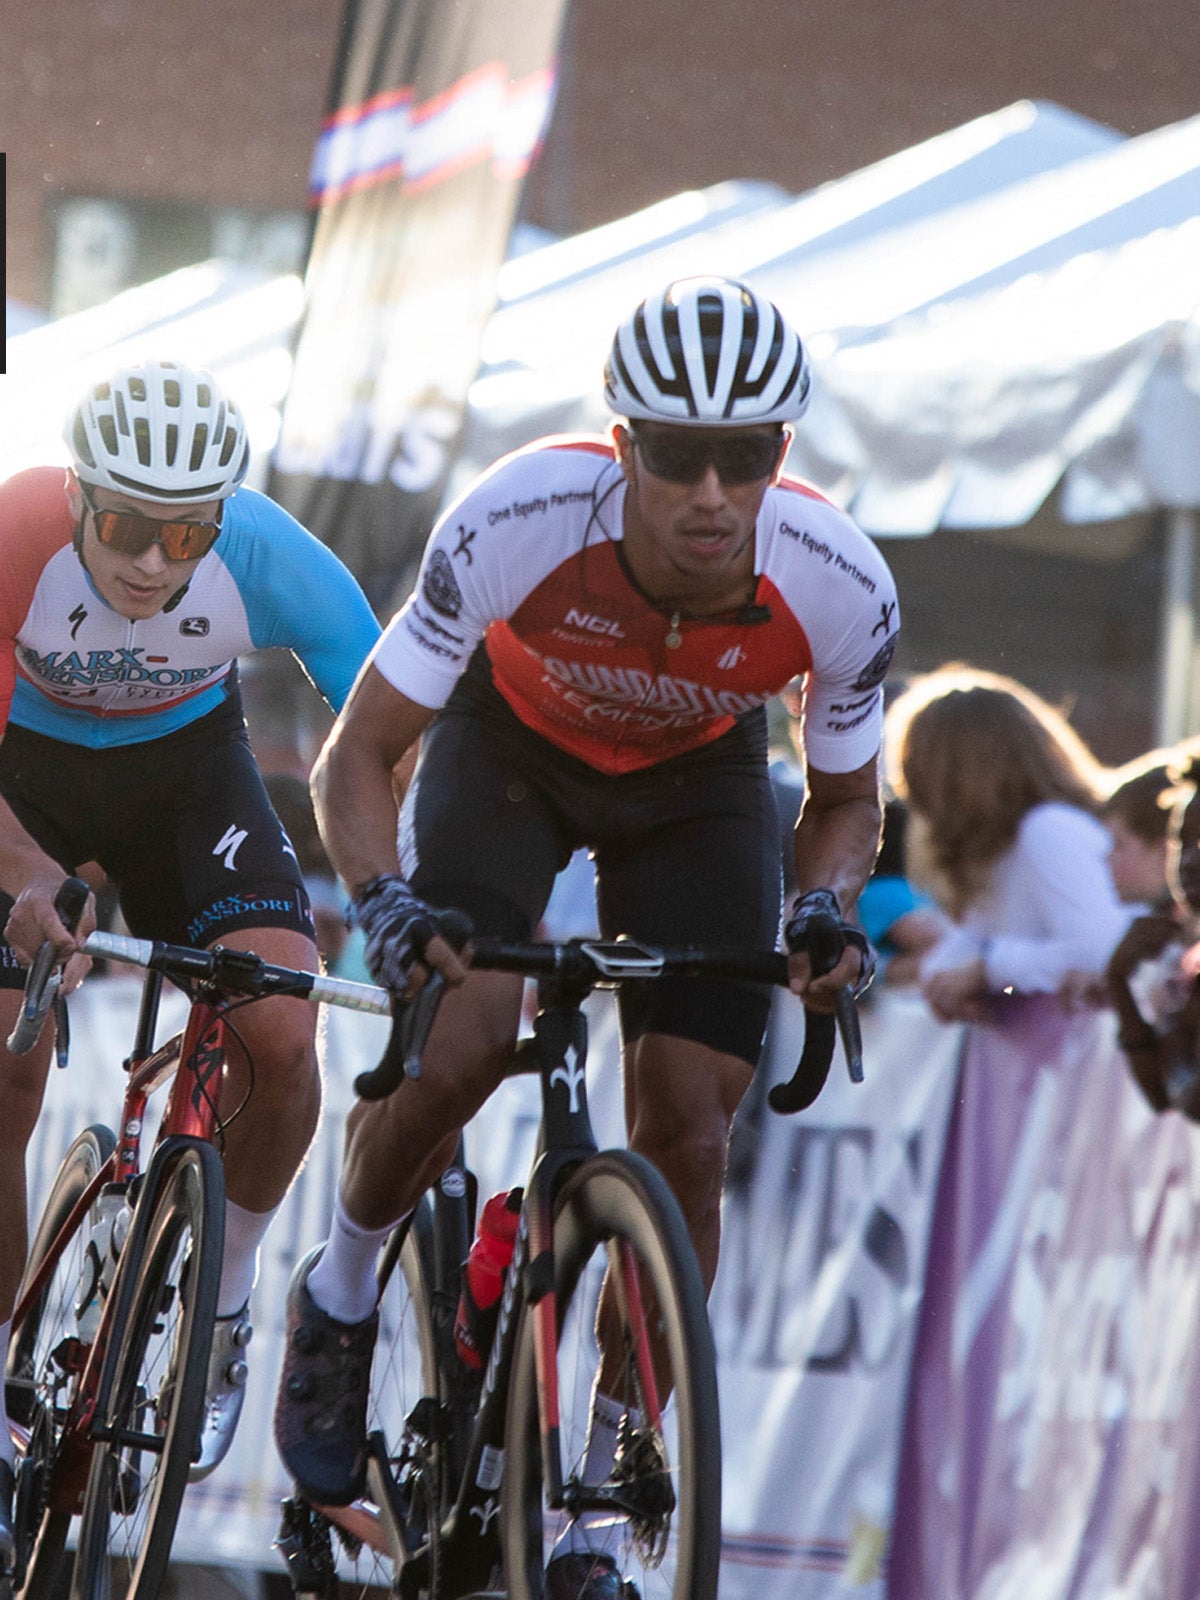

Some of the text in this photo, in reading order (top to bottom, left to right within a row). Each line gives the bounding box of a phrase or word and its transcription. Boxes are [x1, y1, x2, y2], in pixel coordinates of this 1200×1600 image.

[513, 498, 548, 519] Equity
[780, 522, 876, 595] One Equity Partners
